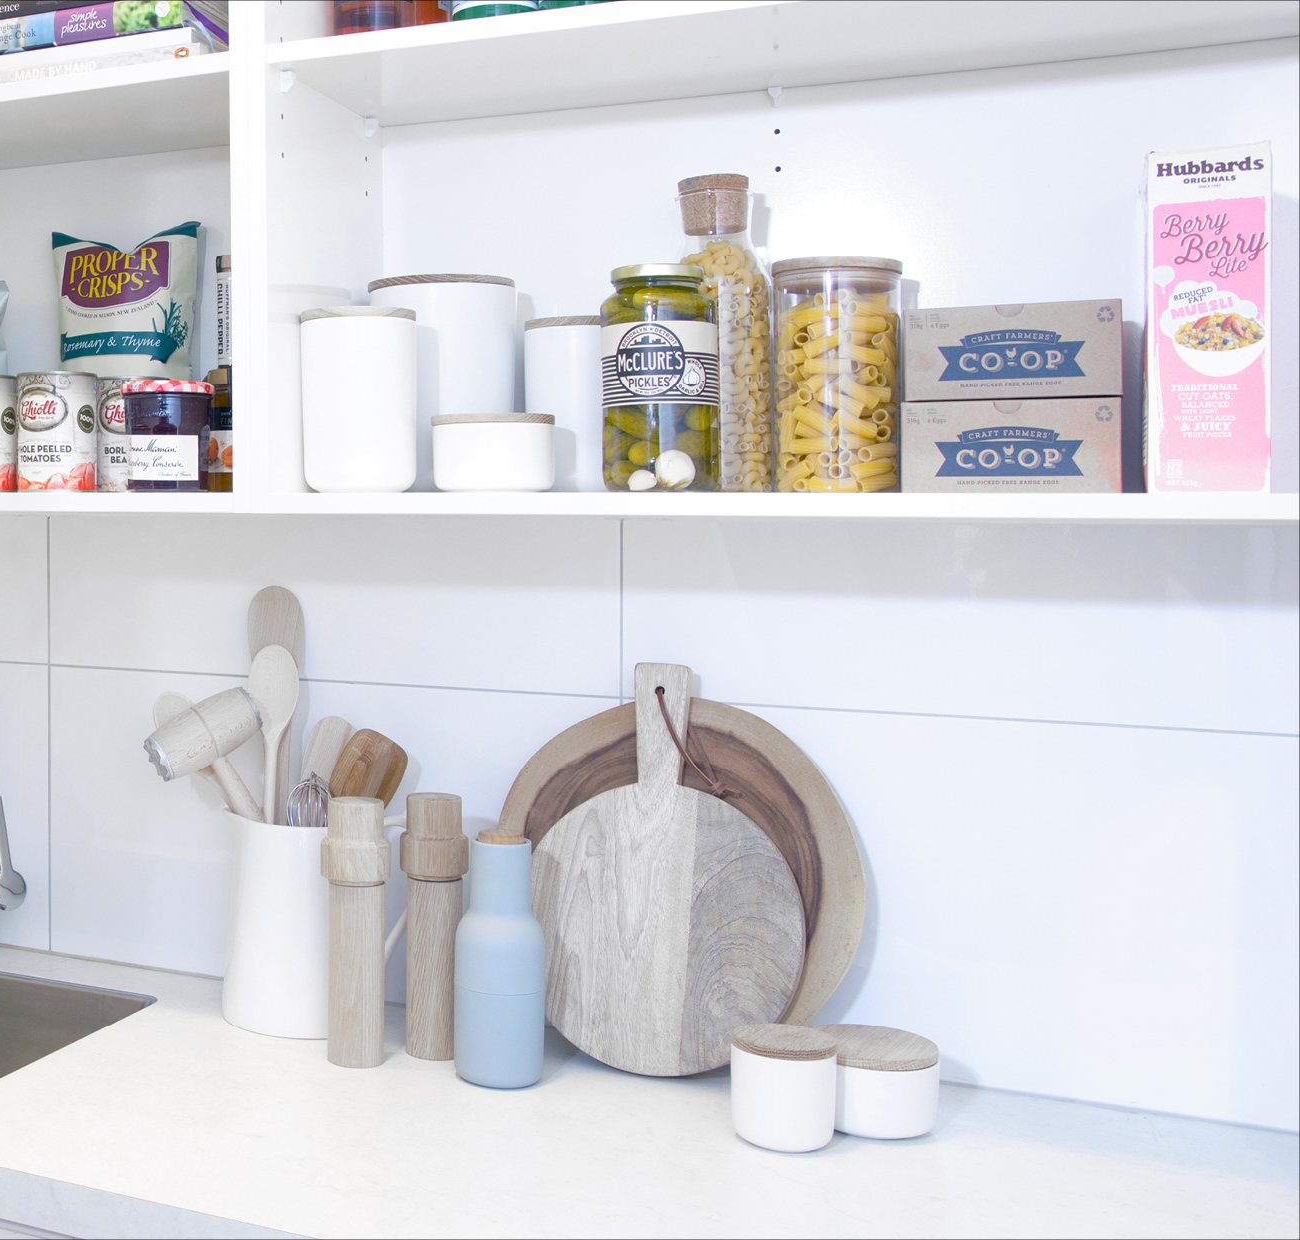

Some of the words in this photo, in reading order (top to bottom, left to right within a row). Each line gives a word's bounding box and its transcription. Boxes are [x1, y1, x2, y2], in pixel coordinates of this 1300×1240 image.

[70, 8, 98, 23] simple
[15, 29, 37, 40] Cook
[61, 18, 107, 38] pleasures
[15, 69, 46, 82] MADE
[48, 65, 62, 77] BY
[66, 61, 96, 74] HAND
[1156, 155, 1265, 177] Hubbards
[1183, 175, 1237, 185] ORIGINALS
[1159, 212, 1230, 239] Berry
[1173, 231, 1269, 265] Berry
[69, 247, 159, 285] PROPER
[1208, 255, 1248, 278] Lite
[77, 271, 144, 298] CRISPS
[1173, 286, 1214, 301] REDUCED
[131, 301, 155, 313] ZEALAND
[1170, 296, 1234, 320] MUESLI
[621, 327, 648, 347] BROOKLYN
[654, 327, 678, 345] DETROIT
[971, 333, 1002, 344] CRAFT
[1005, 332, 1054, 341] FARMERS'
[63, 338, 105, 354] Rosemary
[107, 336, 117, 346] &
[121, 335, 161, 353] Thyme
[618, 350, 684, 372] McCLURE'S
[628, 377, 670, 388] PICKLES
[1170, 384, 1239, 392] TRADITIONAL
[1177, 392, 1200, 401] CUT
[1202, 392, 1234, 401] OATS.
[21, 400, 58, 422] Ghiotti
[1181, 401, 1230, 409] BALANCED
[906, 417, 920, 425] 318g
[932, 417, 947, 425] Eggs
[1180, 422, 1191, 432] &
[1193, 421, 1232, 432] JUICY
[968, 430, 1000, 440] CRAFT
[1003, 429, 1051, 439] FARMERS'
[18, 445, 35, 453] OLE
[37, 445, 72, 453] PEELED
[104, 447, 126, 455] BORL
[144, 438, 177, 453] Maman
[20, 454, 61, 463] TOMATOES
[152, 455, 183, 468] Conserve
[1167, 464, 1183, 473] NZ
